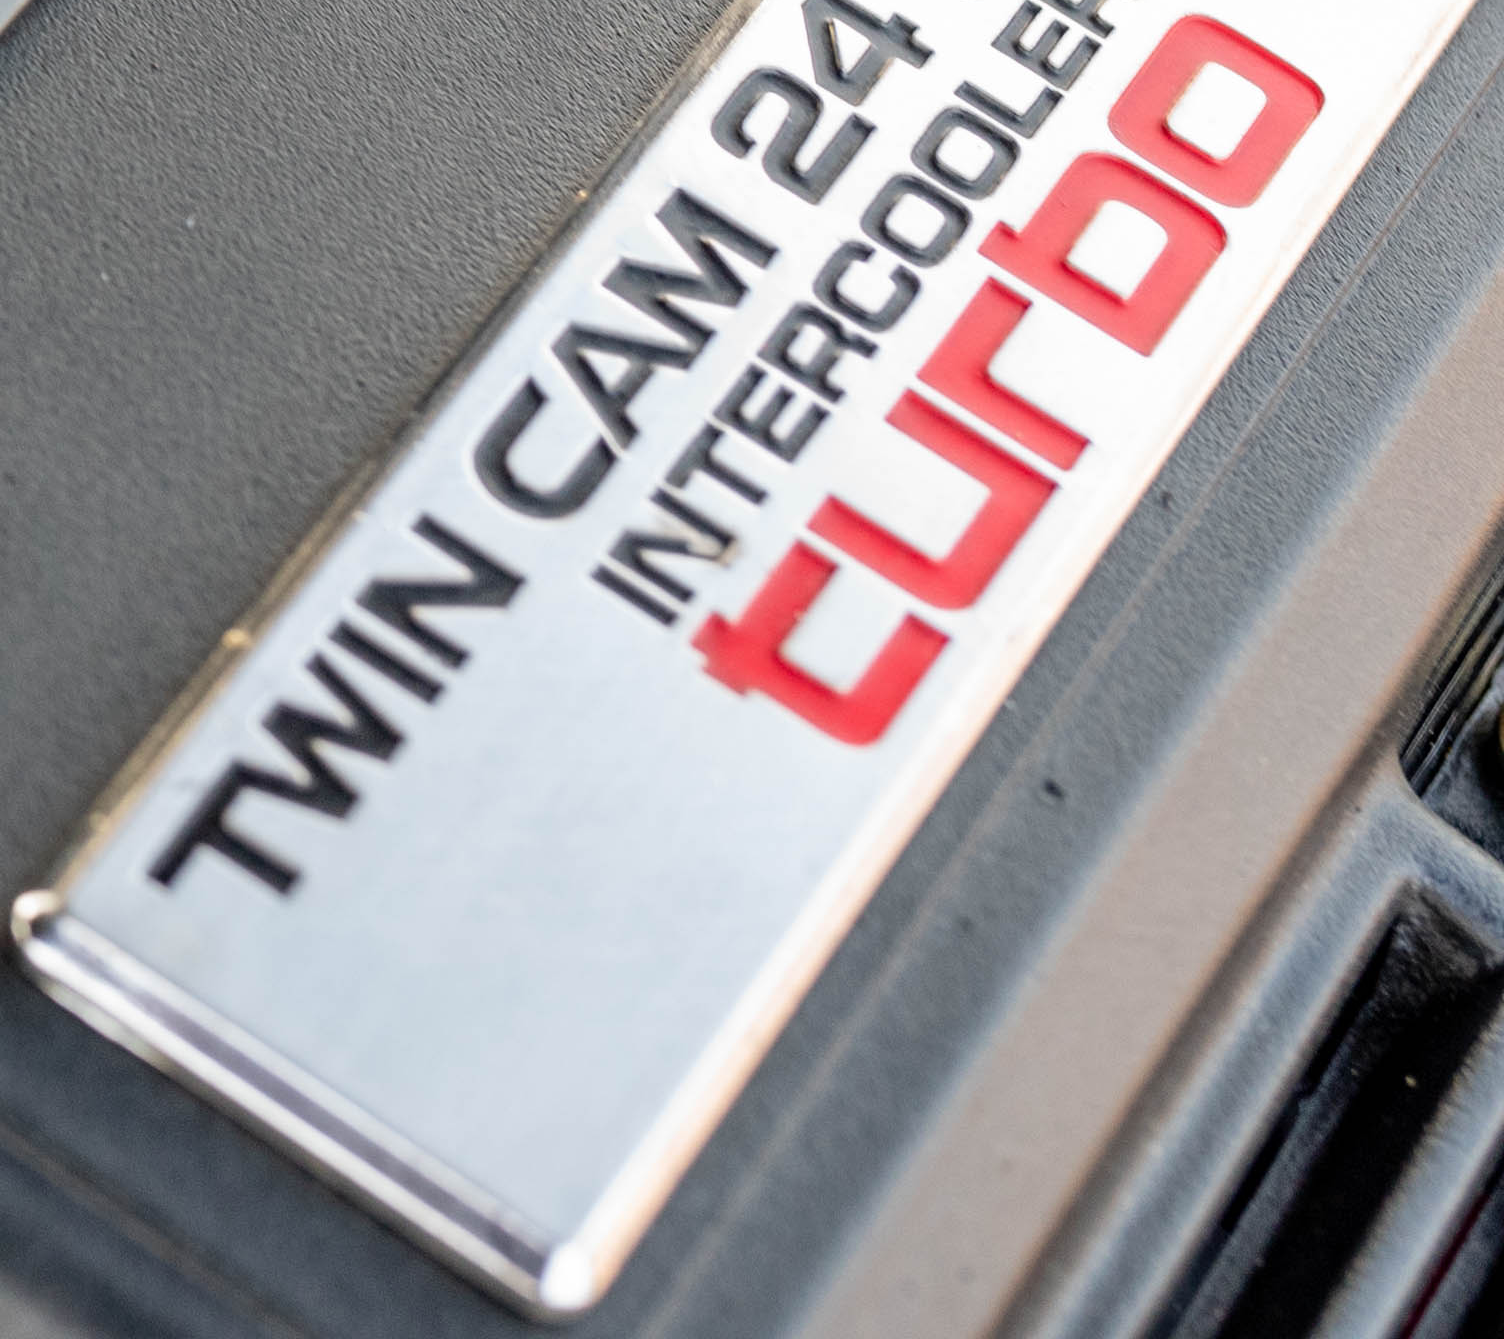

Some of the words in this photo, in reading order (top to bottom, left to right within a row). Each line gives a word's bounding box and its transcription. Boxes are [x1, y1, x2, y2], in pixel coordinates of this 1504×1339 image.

[151, 512, 526, 897] TWIN
[473, 190, 777, 516] CAM
[693, 14, 1324, 747] turbo
